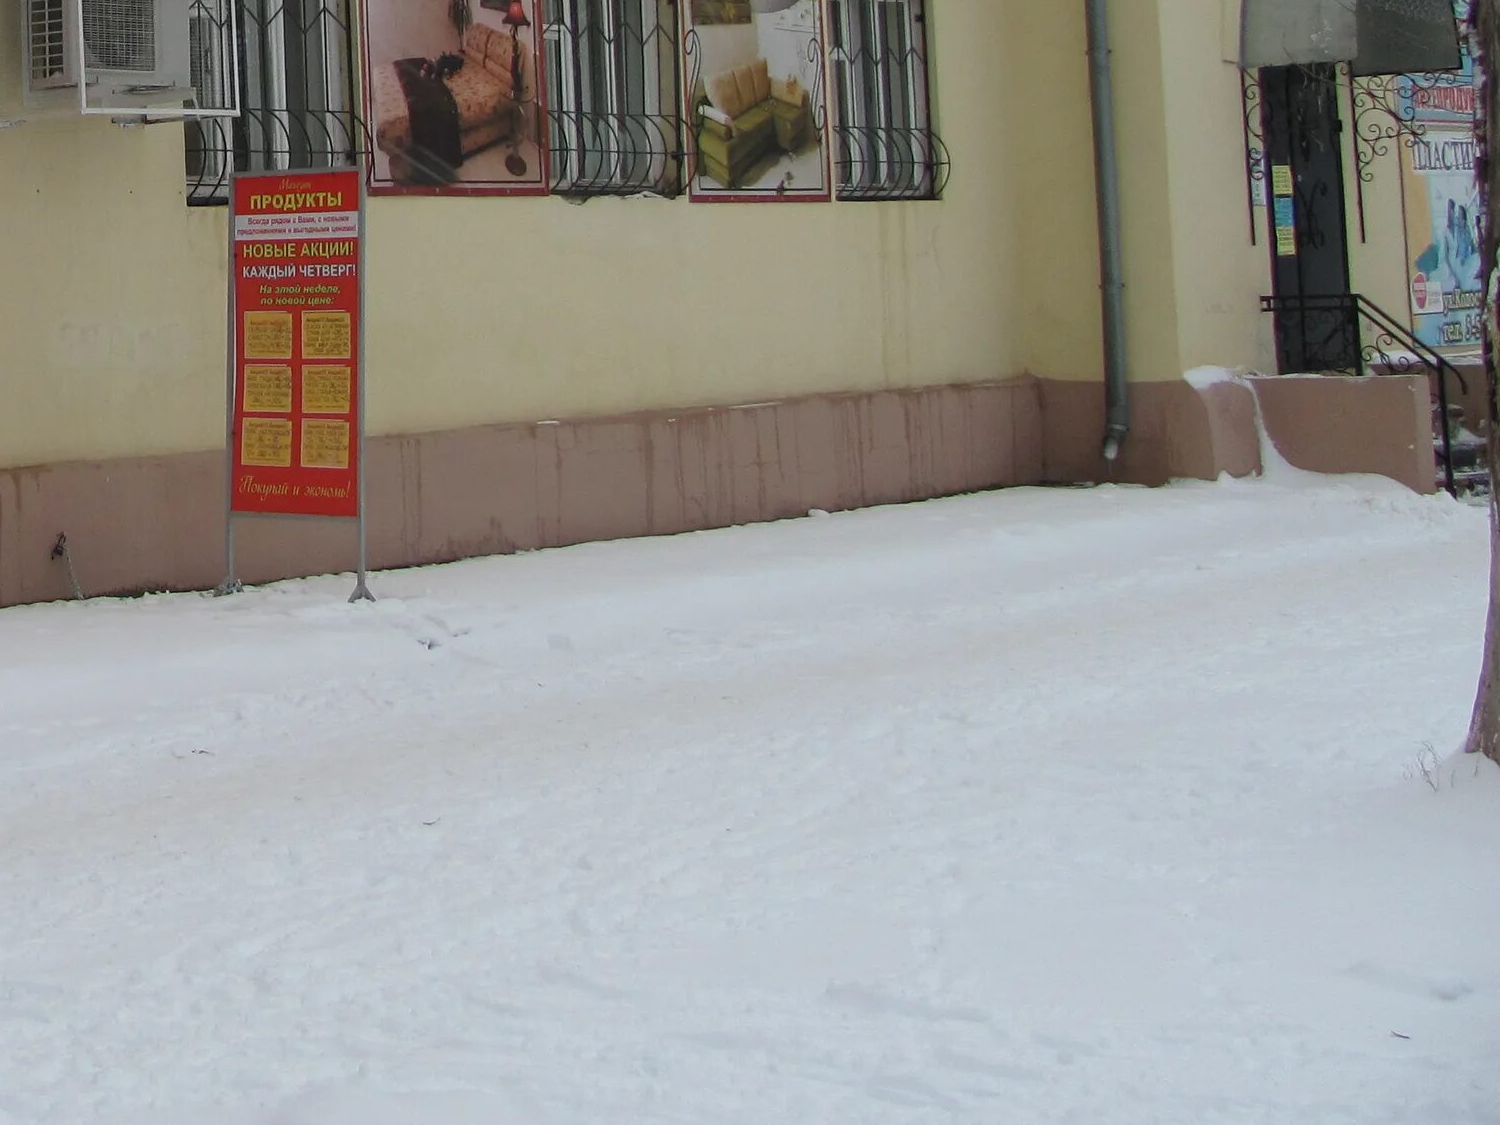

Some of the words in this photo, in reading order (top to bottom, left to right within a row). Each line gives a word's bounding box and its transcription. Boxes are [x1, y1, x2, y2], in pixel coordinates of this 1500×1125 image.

[250, 191, 342, 211] ПРОДУКТЫ
[243, 243, 296, 258] НОВЫЕ
[300, 241, 354, 259] АКЦИИ!
[242, 262, 296, 279] КАЖДЫЙ
[299, 263, 356, 277] ЧЕТВЕРГ!
[259, 284, 272, 294] На
[275, 284, 301, 294] этой
[303, 284, 341, 295] неделе,
[275, 296, 306, 305] новой
[307, 296, 335, 307] цене:
[238, 475, 288, 502] Покупай
[292, 484, 300, 496] и
[303, 479, 351, 498] экономь!
